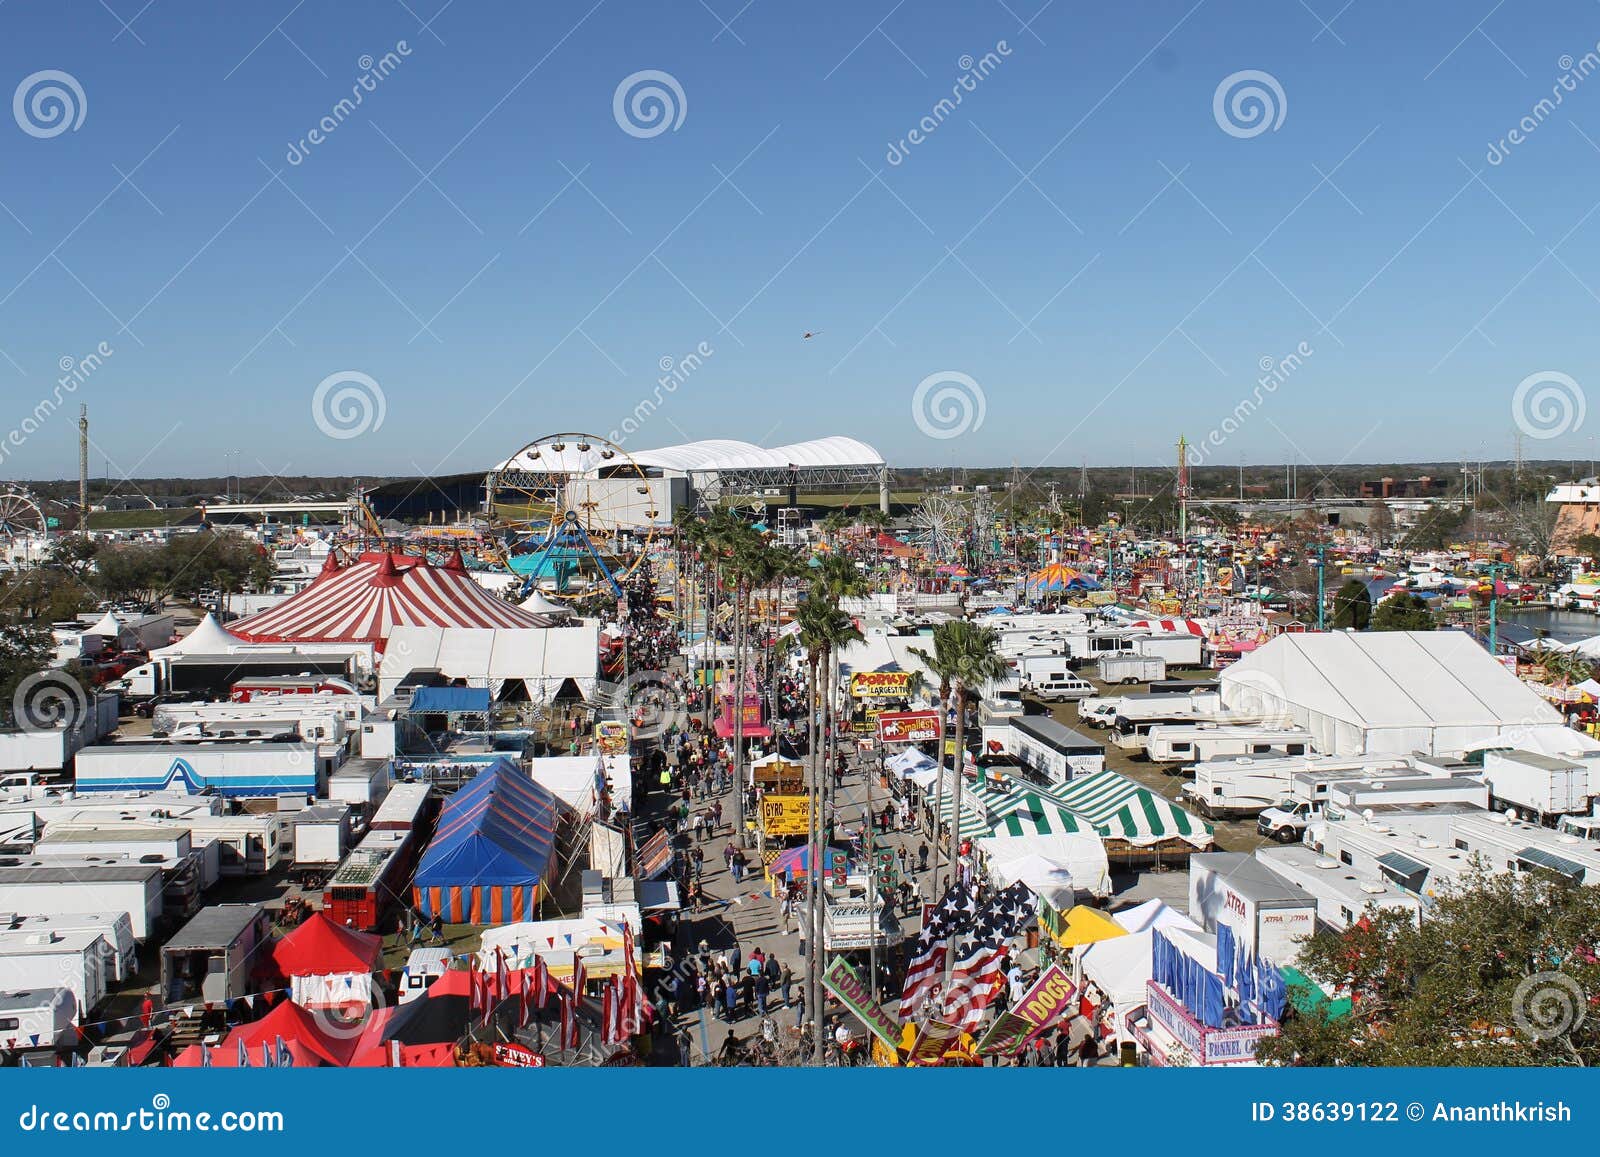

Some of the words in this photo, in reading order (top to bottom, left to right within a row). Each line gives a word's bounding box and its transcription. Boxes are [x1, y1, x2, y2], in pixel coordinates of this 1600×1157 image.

[896, 718, 934, 736] Smallest
[908, 730, 936, 738] HORSE
[765, 802, 783, 817] GYRO
[1026, 972, 1072, 1021] DOGS
